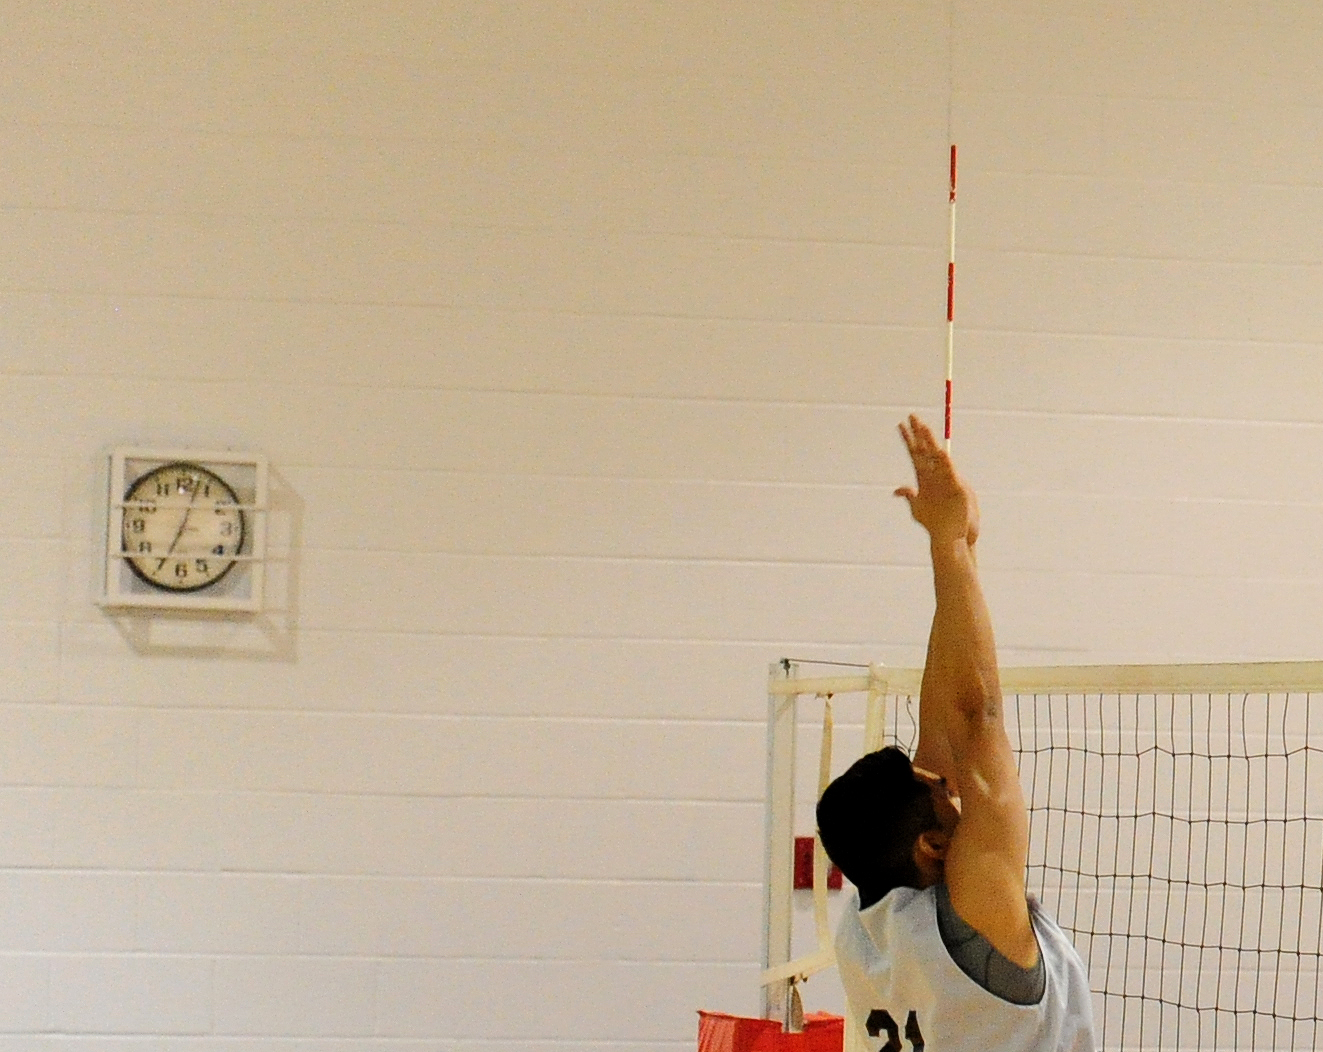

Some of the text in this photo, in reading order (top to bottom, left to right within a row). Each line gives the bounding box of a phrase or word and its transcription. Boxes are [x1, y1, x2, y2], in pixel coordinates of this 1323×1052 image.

[157, 484, 168, 496] 11
[132, 519, 145, 533] 9
[220, 521, 232, 536] 3
[212, 544, 224, 555] 4
[155, 557, 167, 570] 7
[175, 563, 187, 578] 6
[196, 558, 208, 573] 5
